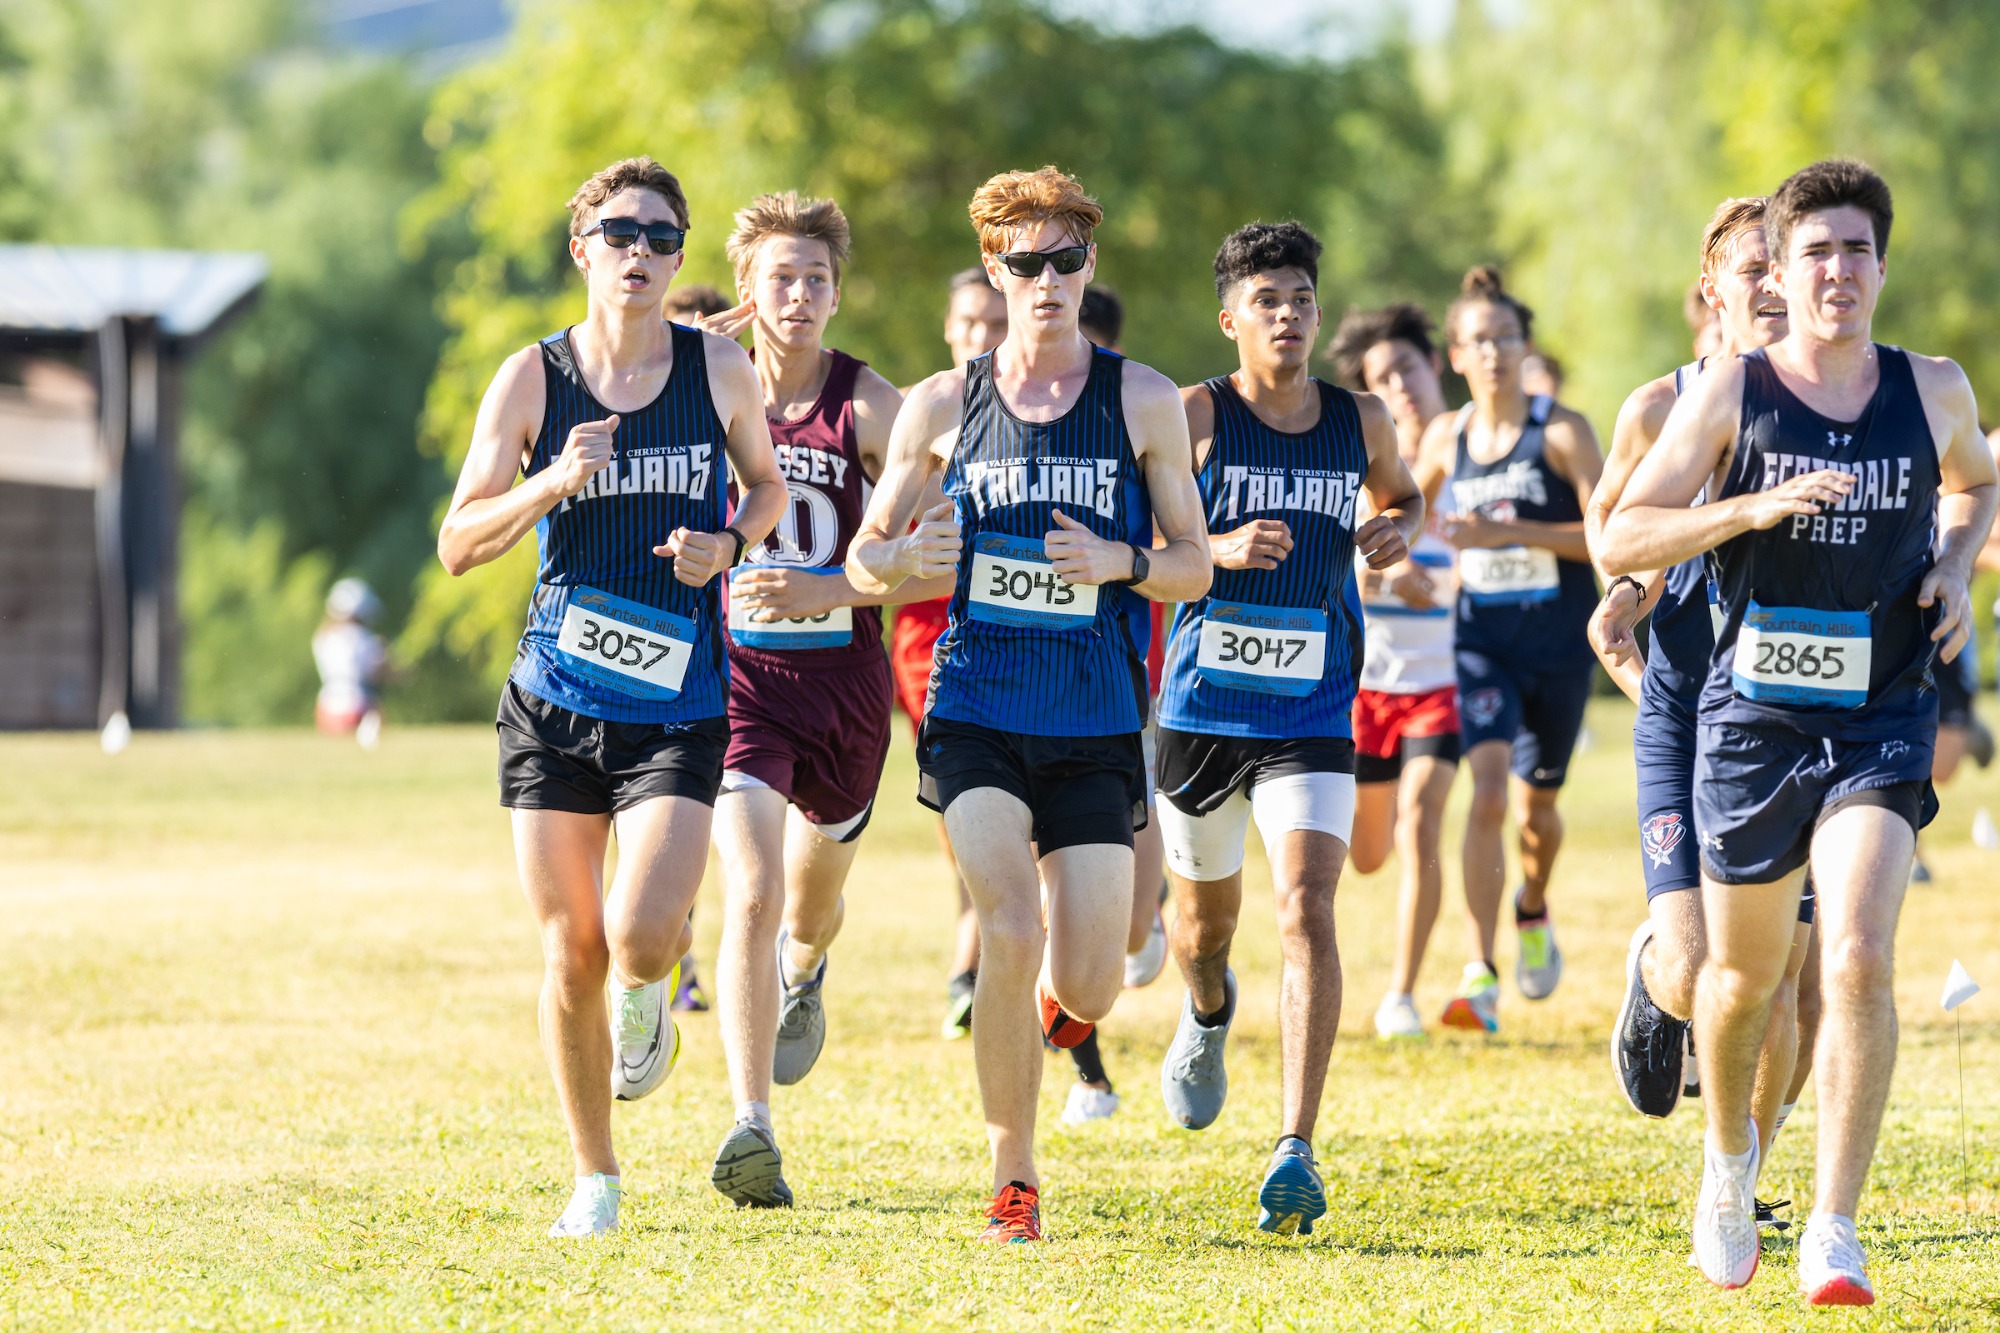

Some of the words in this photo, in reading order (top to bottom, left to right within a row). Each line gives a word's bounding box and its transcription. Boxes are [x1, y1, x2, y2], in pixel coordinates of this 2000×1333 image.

[626, 446, 687, 459] CHRISTIAN
[988, 457, 1029, 467] VALLEY
[1035, 456, 1094, 466] CHRISTIAN
[551, 443, 712, 513] OJANS
[965, 458, 1118, 521] TROJANS
[1249, 466, 1286, 475] VALLEY
[1290, 468, 1344, 479] CHRISTIAN
[1763, 452, 1912, 512] SCDALE
[1223, 465, 1361, 531] TROJANS
[1789, 513, 1868, 545] PREP
[989, 564, 1075, 605] 3043
[653, 619, 682, 637] Hills
[1287, 617, 1313, 630] Hills
[1827, 622, 1857, 636] Hills
[577, 618, 671, 672] 3057
[1218, 630, 1307, 668] 3047
[1752, 641, 1845, 679] 2865
[617, 673, 657, 691] Invitational
